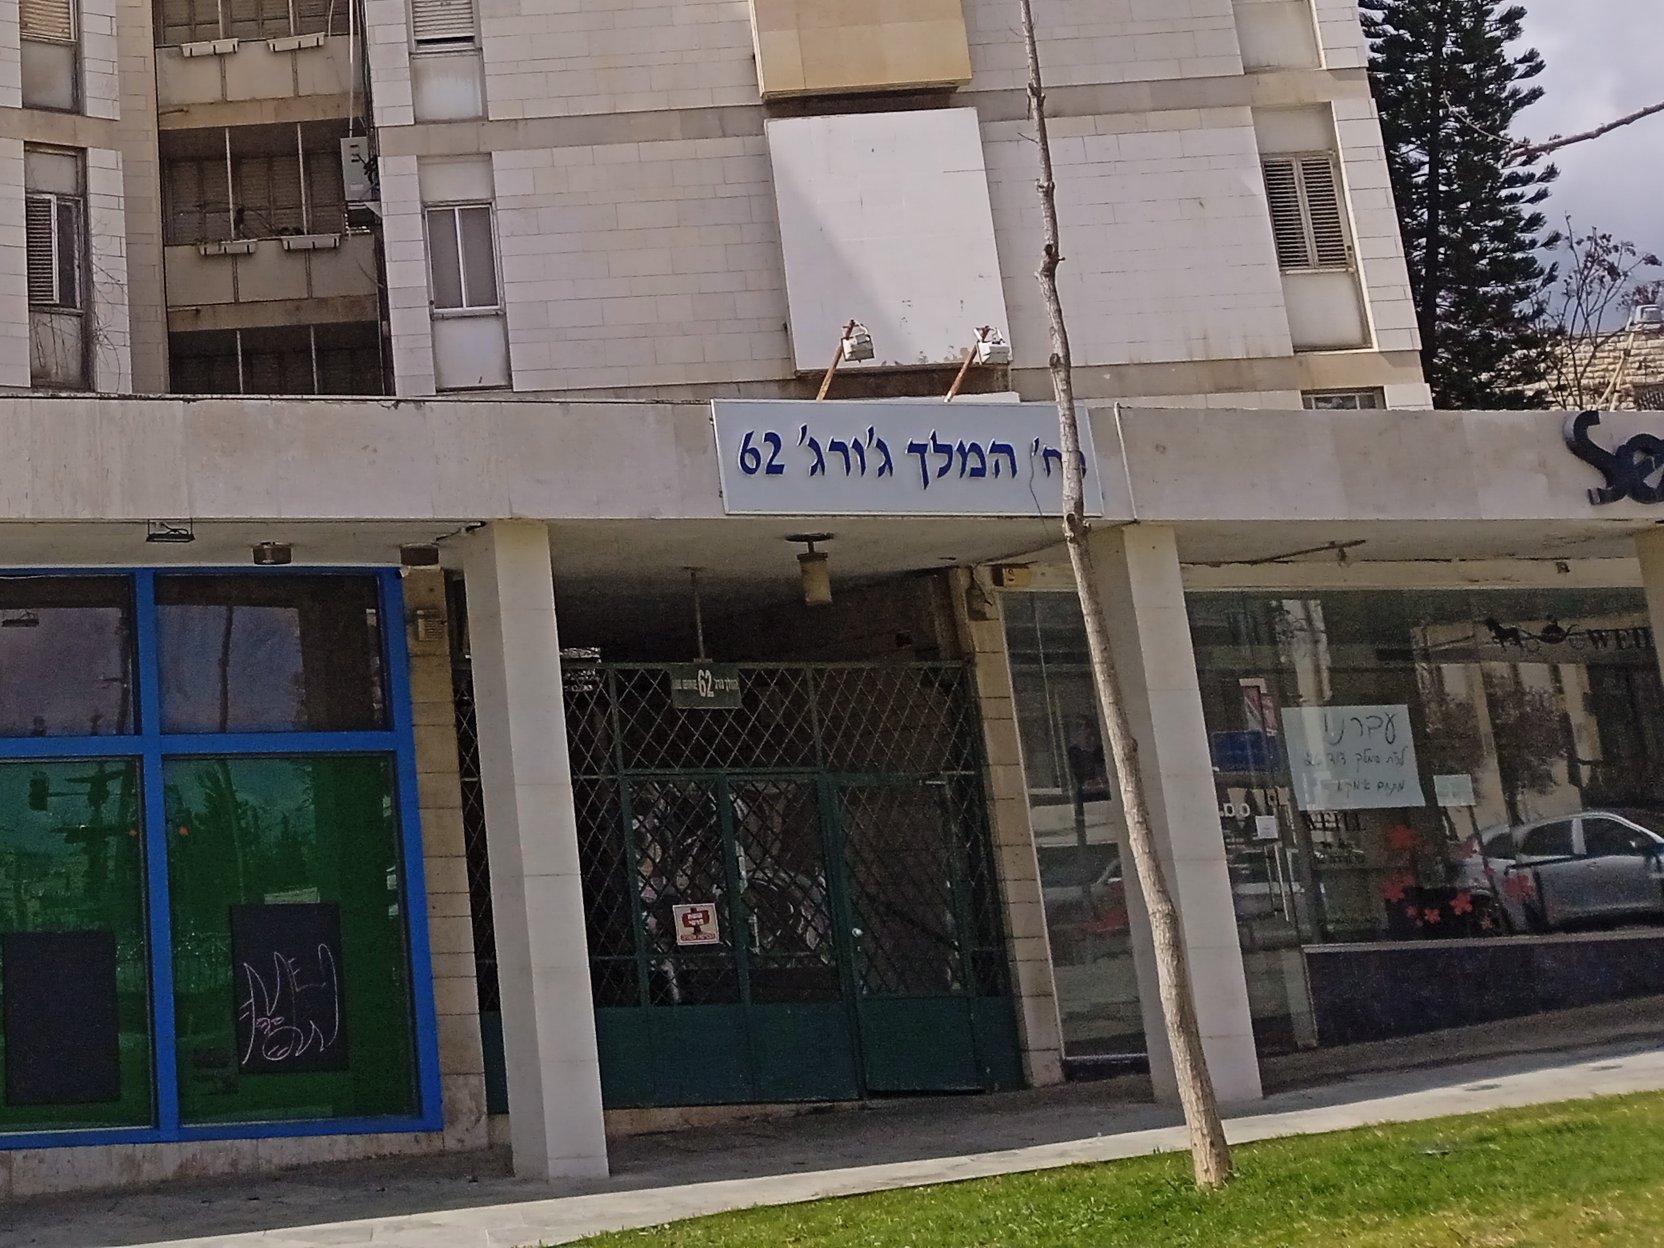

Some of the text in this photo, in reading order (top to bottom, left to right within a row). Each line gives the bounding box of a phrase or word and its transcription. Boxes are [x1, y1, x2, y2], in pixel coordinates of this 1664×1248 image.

[738, 430, 784, 476] 62
[905, 429, 1018, 490] המלך
[698, 669, 714, 697] 62
[1323, 711, 1397, 746] עברנו
